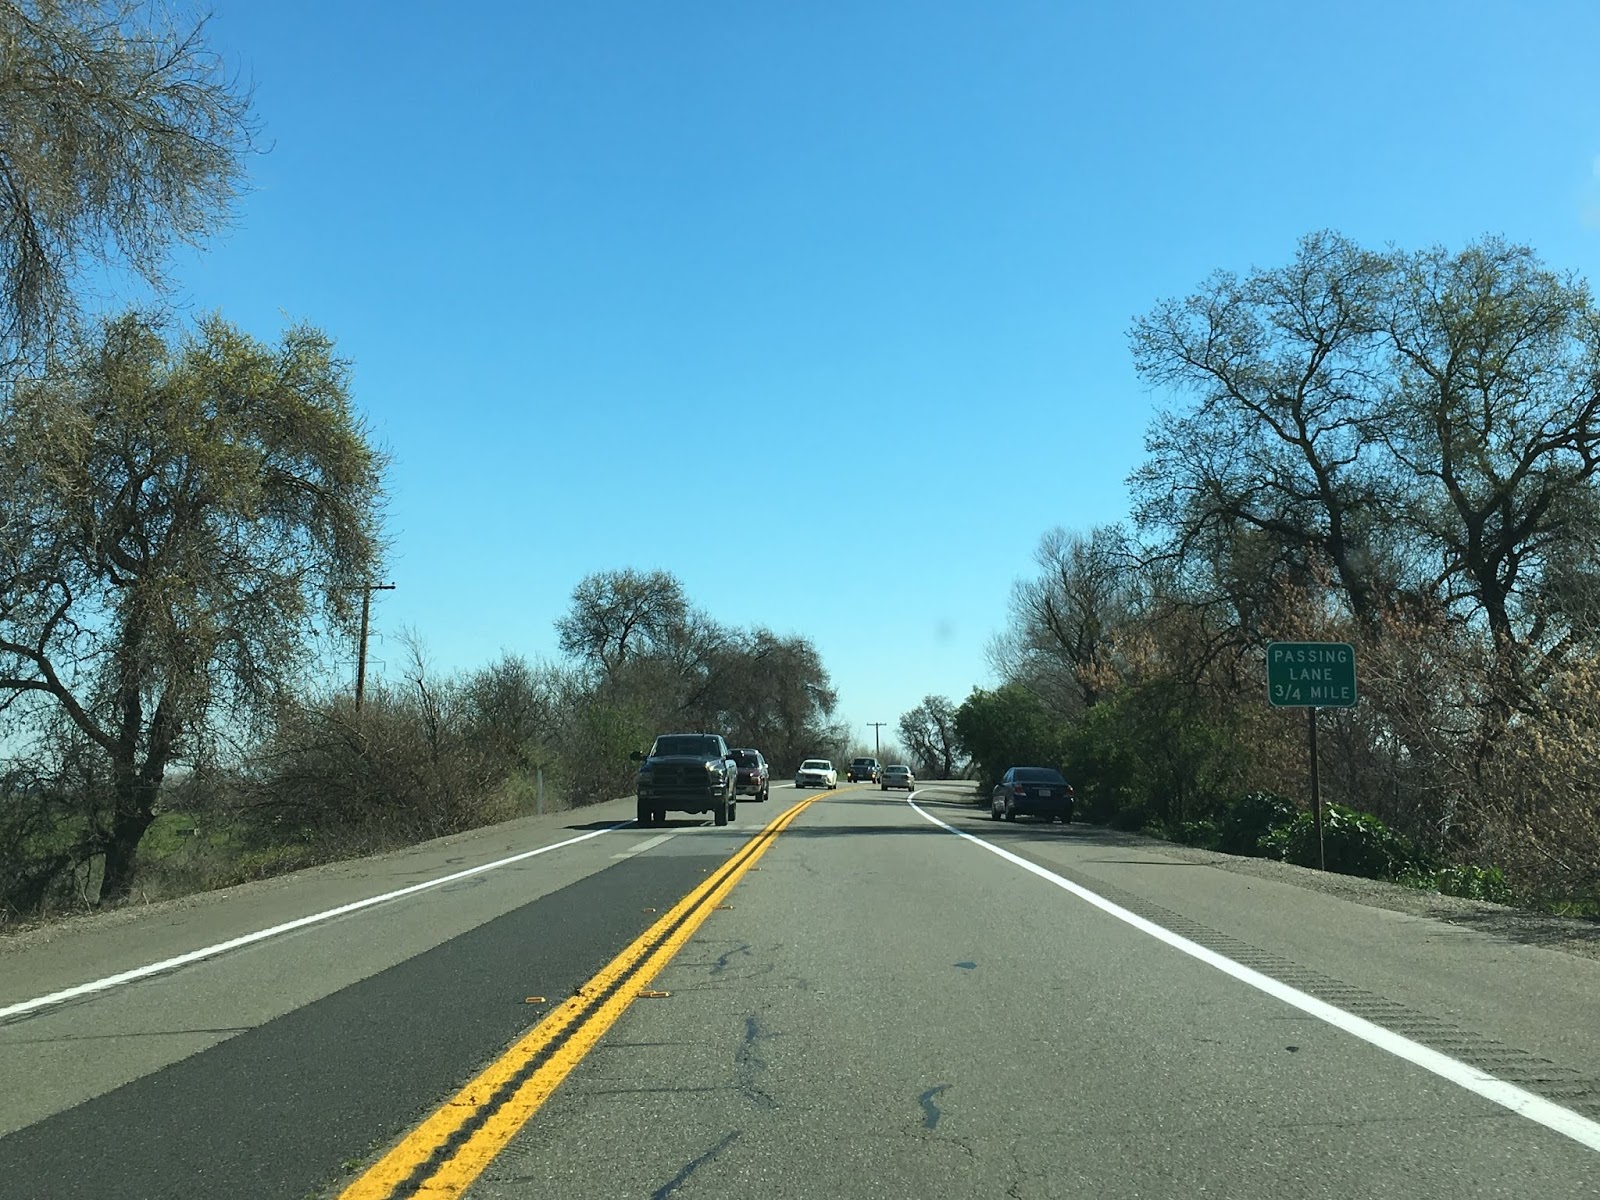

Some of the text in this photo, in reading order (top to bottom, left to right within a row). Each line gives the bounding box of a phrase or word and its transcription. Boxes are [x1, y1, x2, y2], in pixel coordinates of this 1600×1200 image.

[1274, 650, 1347, 663] PASSING
[1289, 668, 1332, 680] LANE
[1275, 684, 1350, 700] 3/4 MILE
